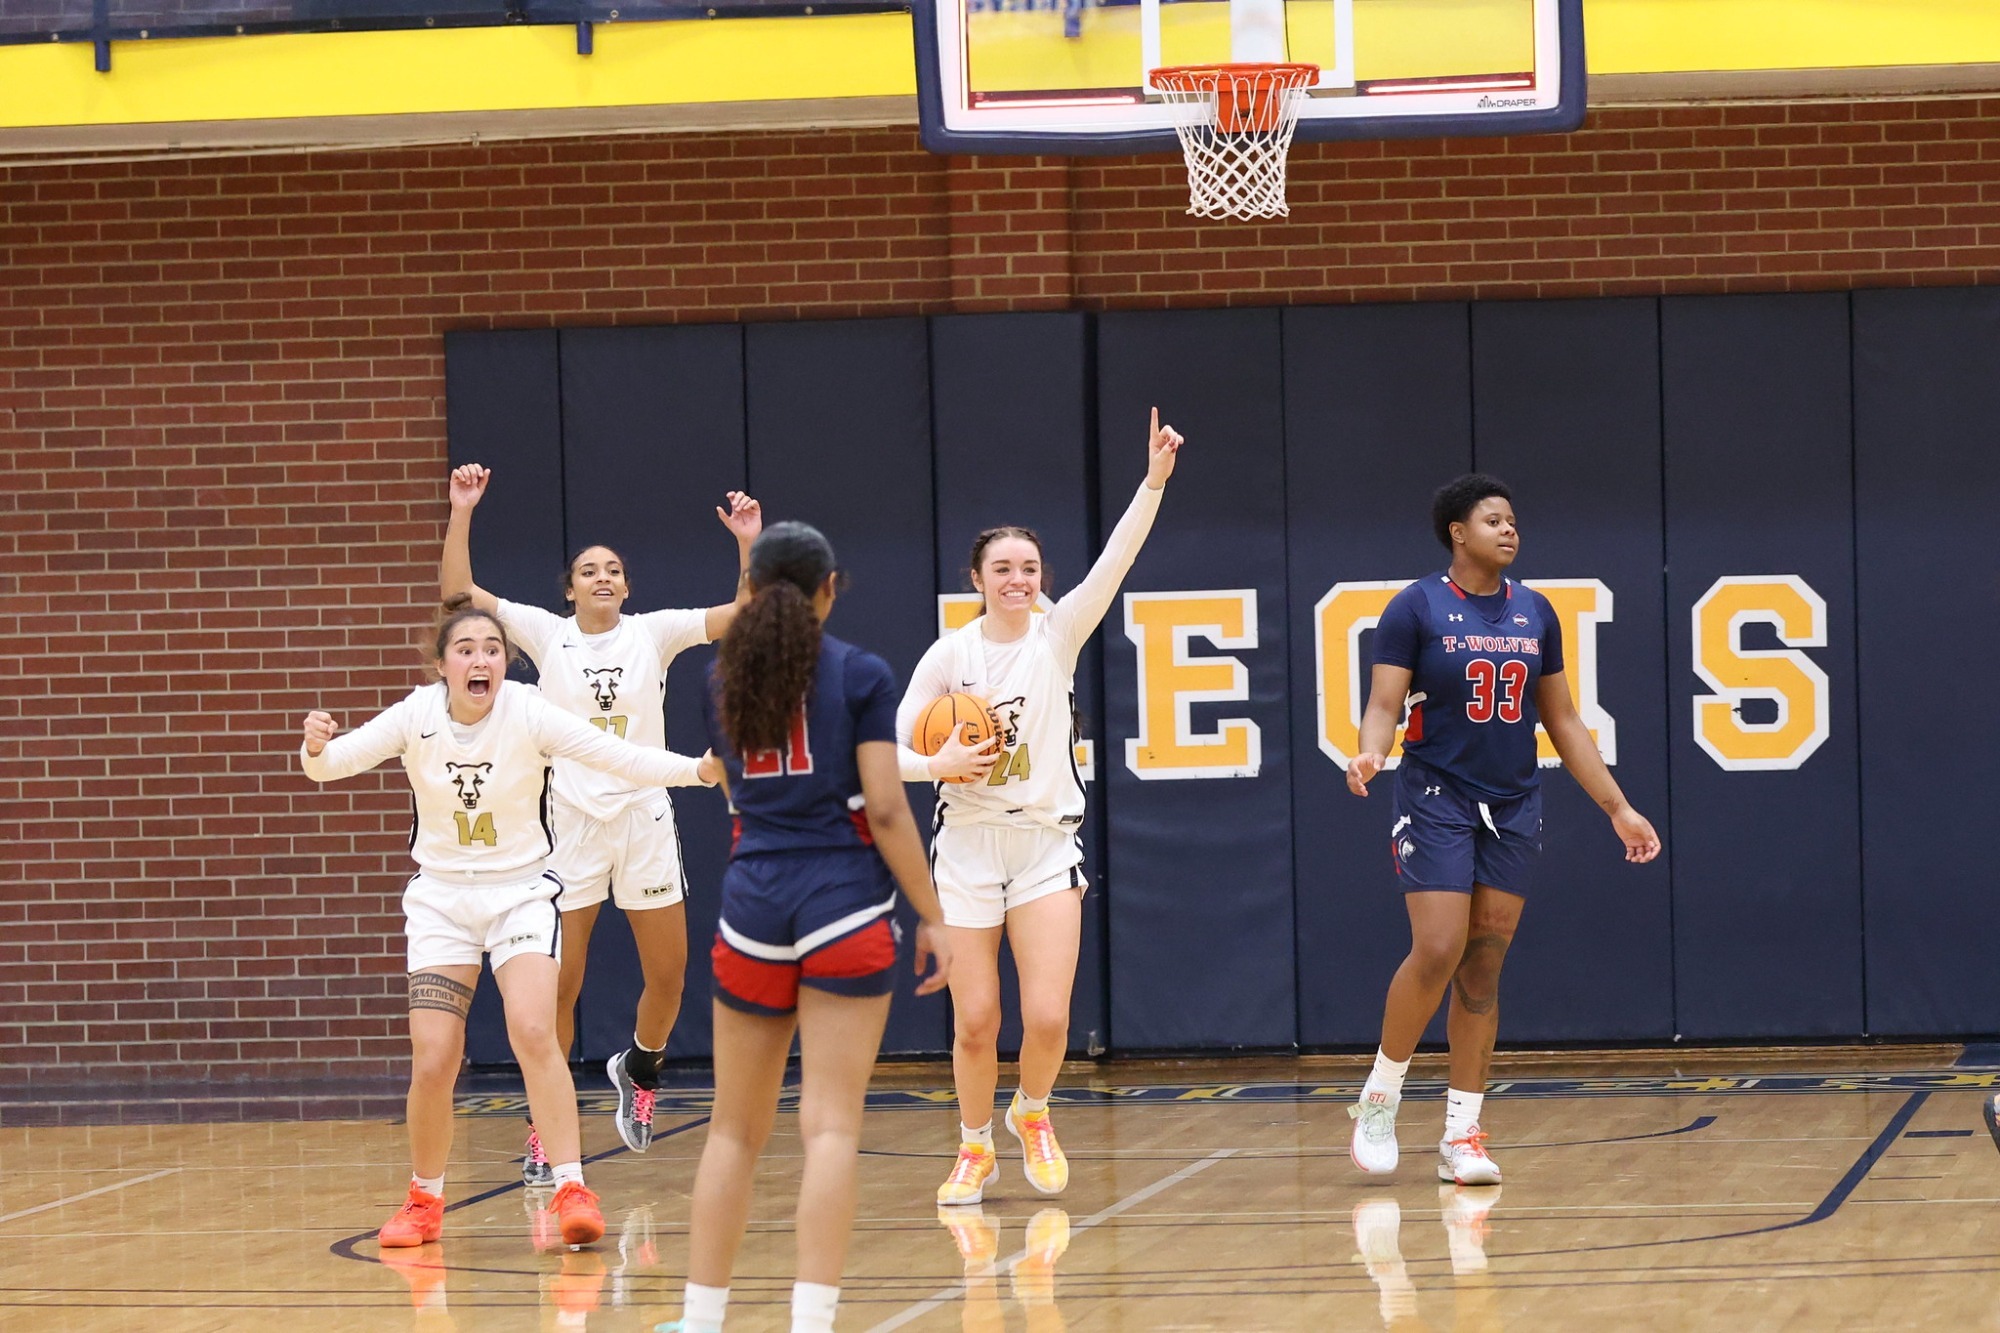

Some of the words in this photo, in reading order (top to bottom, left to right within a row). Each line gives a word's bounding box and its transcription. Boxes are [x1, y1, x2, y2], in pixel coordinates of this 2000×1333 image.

[1496, 98, 1536, 108] DRAPER
[1443, 635, 1539, 655] T-WOLVES
[1466, 658, 1528, 723] 33
[986, 743, 1030, 786] 24
[453, 810, 497, 846] 14
